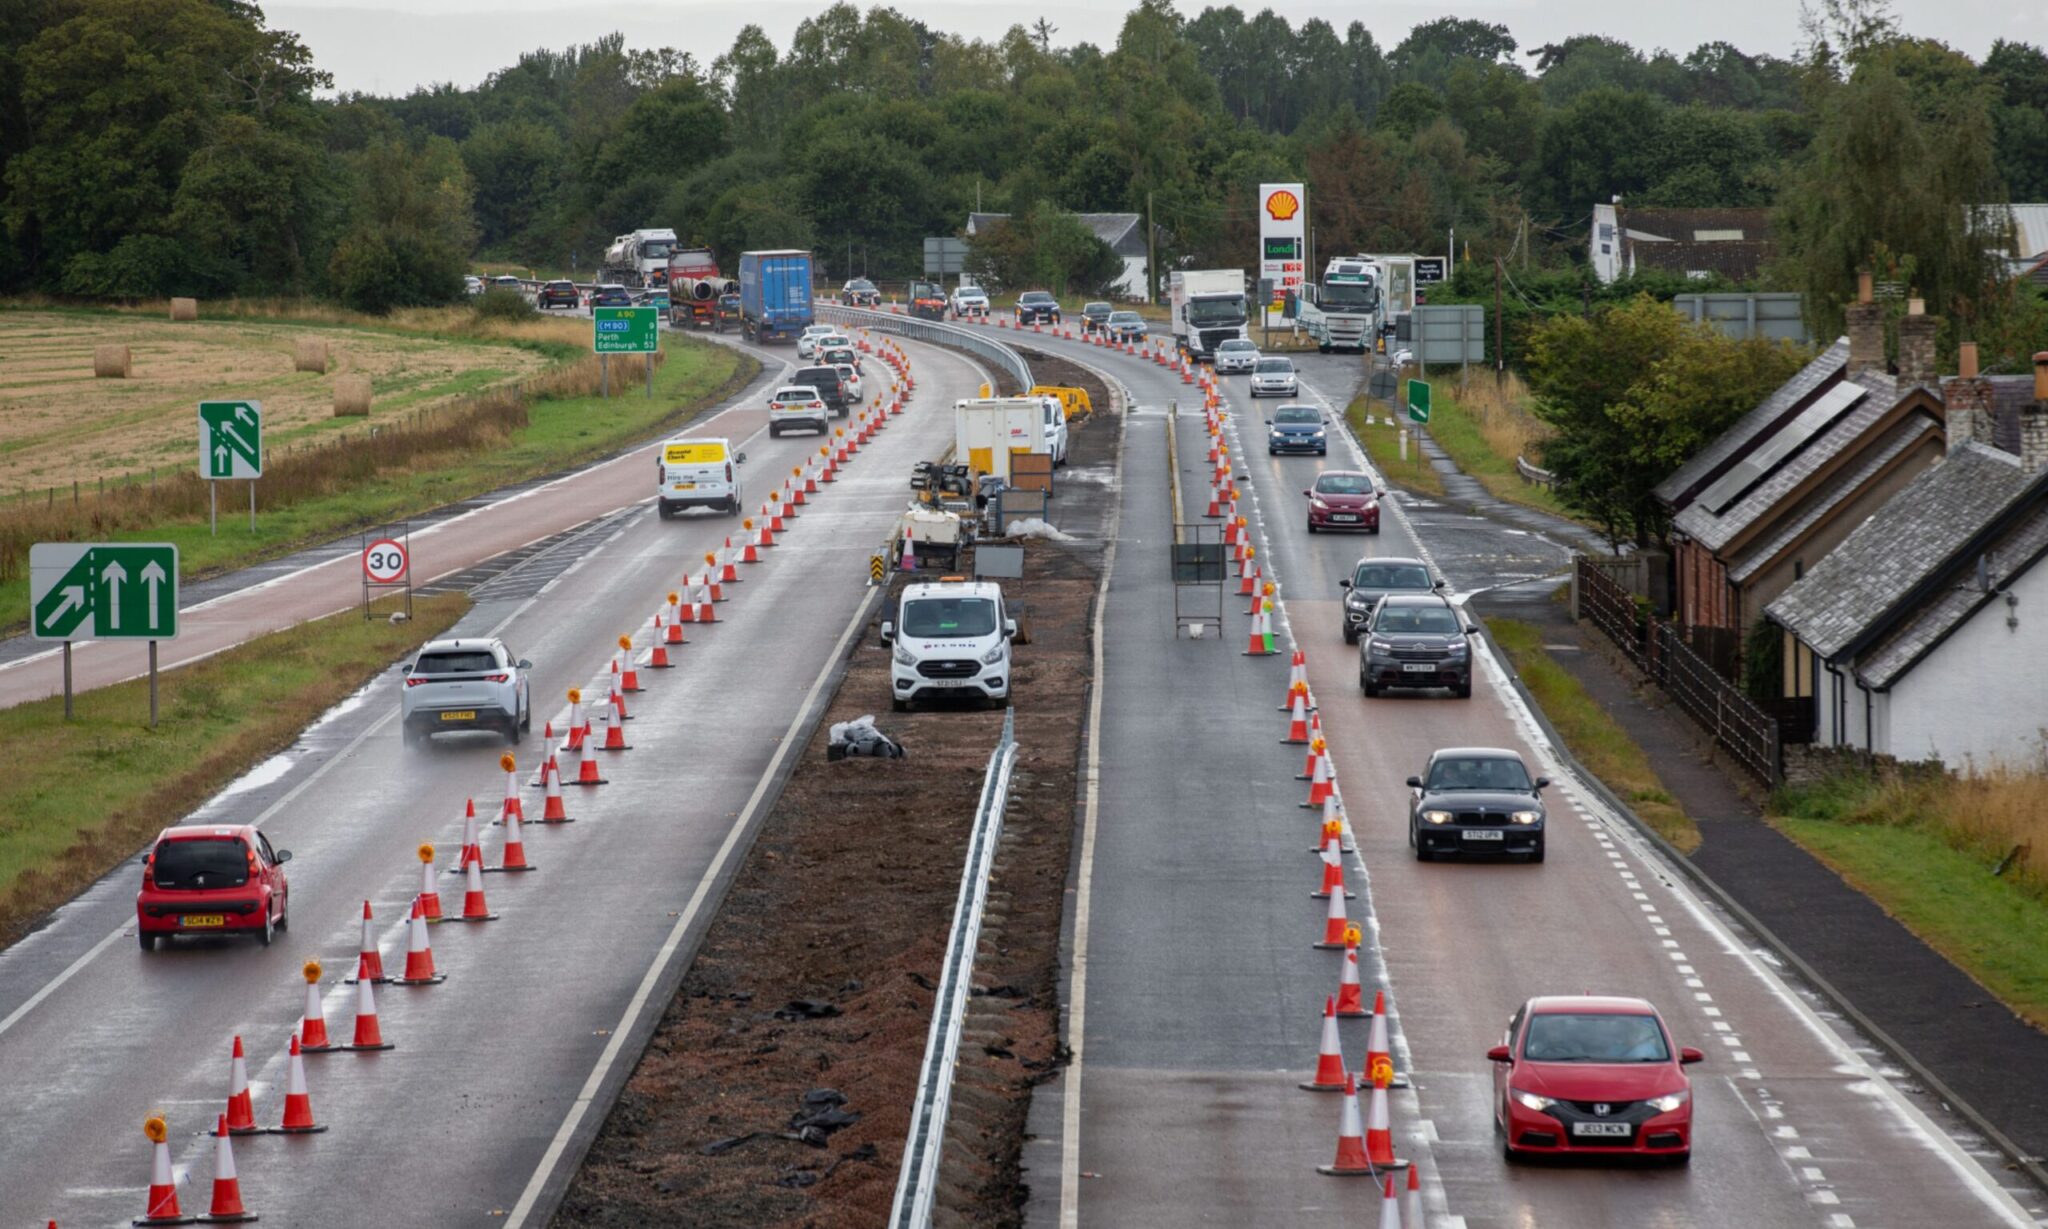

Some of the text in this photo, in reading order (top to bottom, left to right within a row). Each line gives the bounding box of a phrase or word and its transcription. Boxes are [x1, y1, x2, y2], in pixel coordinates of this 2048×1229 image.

[1267, 244, 1297, 254] Londi
[648, 321, 655, 330] 9
[597, 341, 654, 350] Edinburgh 53
[370, 552, 402, 570] 30
